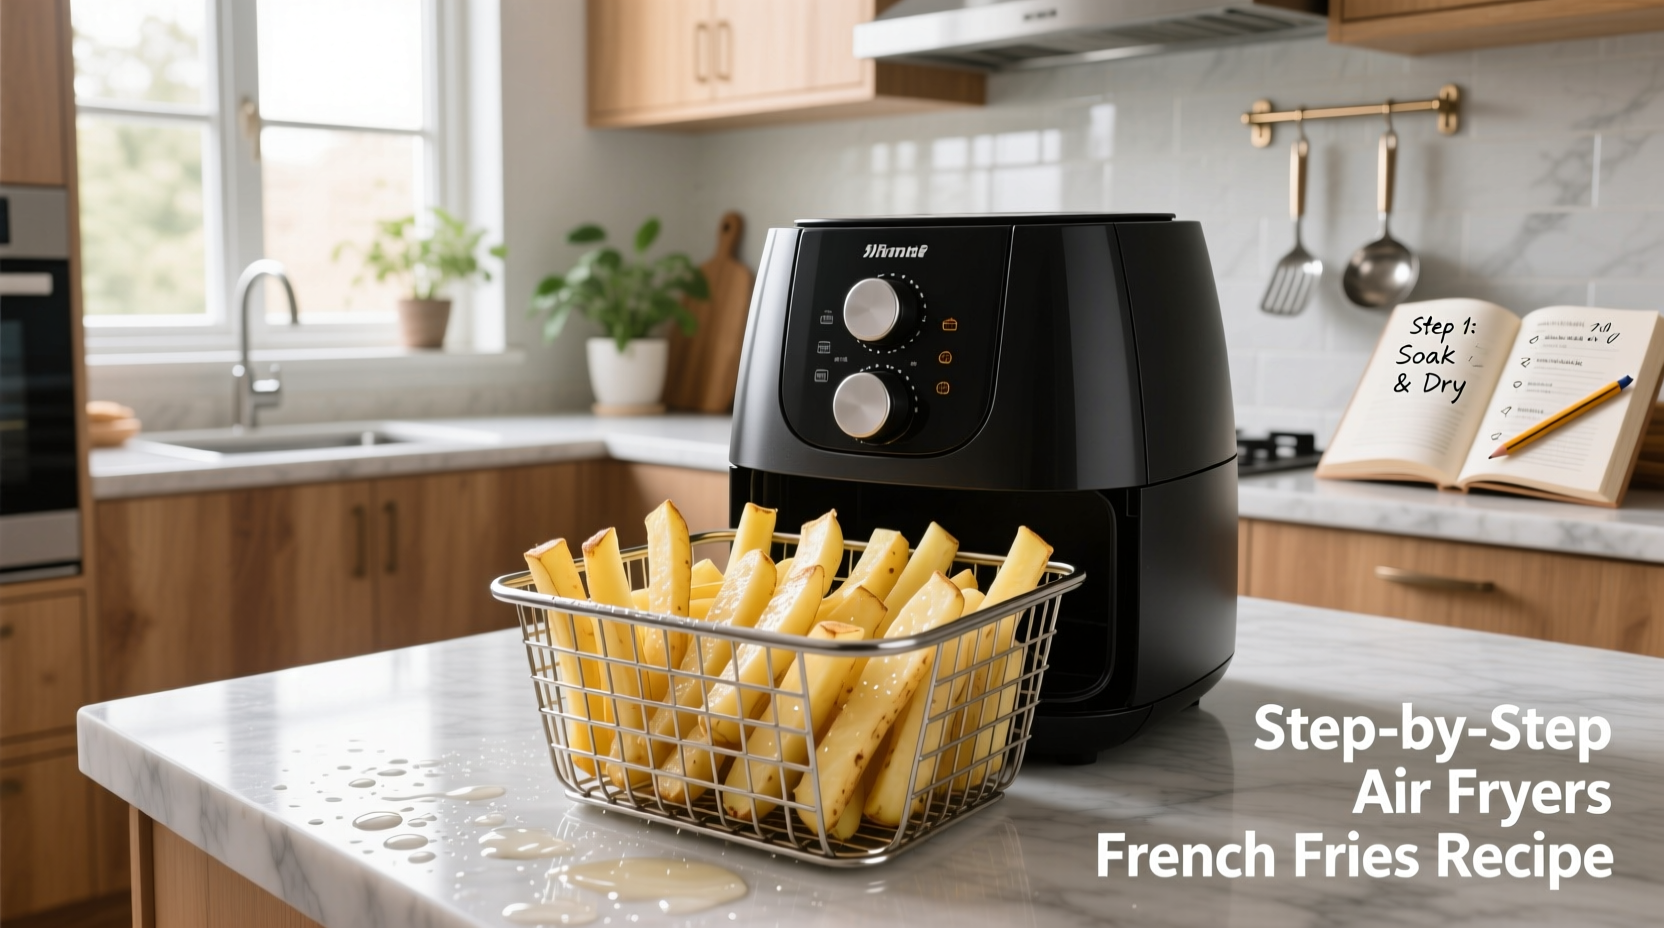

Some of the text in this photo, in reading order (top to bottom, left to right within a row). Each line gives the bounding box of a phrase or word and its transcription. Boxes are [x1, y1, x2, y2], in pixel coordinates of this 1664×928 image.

[1409, 315, 1477, 344] Step 1:
[1395, 344, 1456, 365] Soak
[1393, 372, 1467, 405] & Dry
